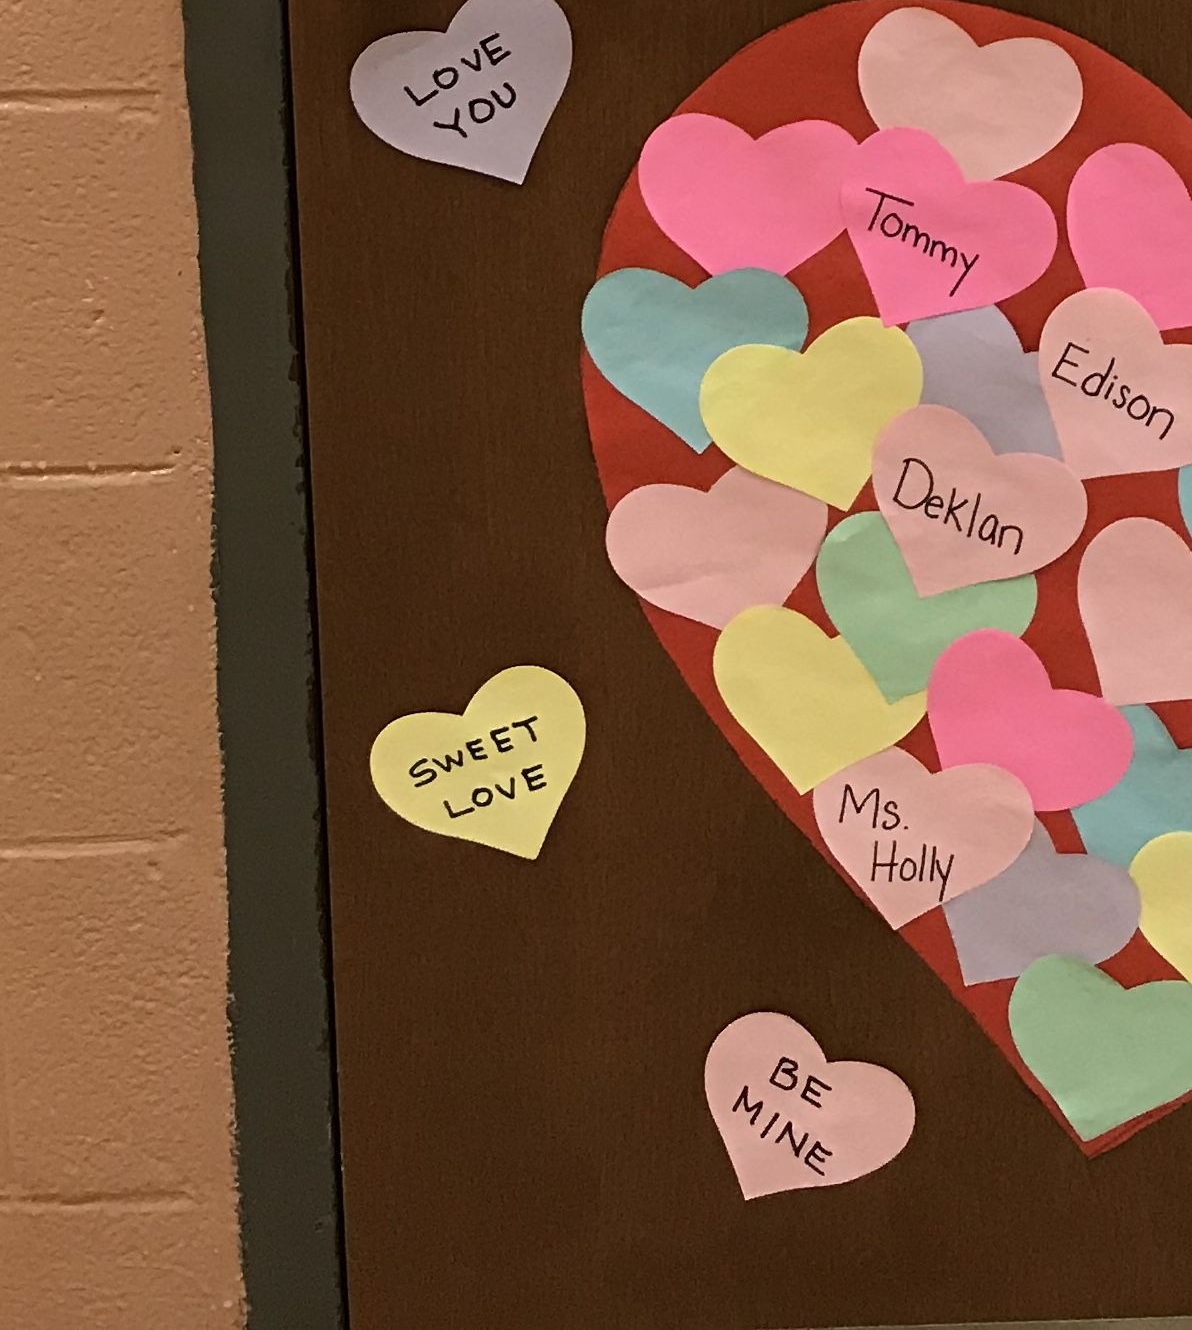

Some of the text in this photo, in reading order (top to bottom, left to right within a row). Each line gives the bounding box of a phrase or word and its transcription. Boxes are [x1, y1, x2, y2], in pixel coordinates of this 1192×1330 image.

[403, 32, 512, 107] LOVE
[432, 82, 517, 139] YOU
[865, 187, 980, 298] Tommy
[1051, 341, 1175, 441] Edison
[891, 456, 1025, 557] Deklan
[408, 715, 539, 788] SWEET
[442, 763, 548, 819] LOVE
[838, 783, 901, 831] Ms.
[870, 839, 955, 903] Holly
[768, 1056, 833, 1109] BE
[731, 1084, 834, 1177] MINE
